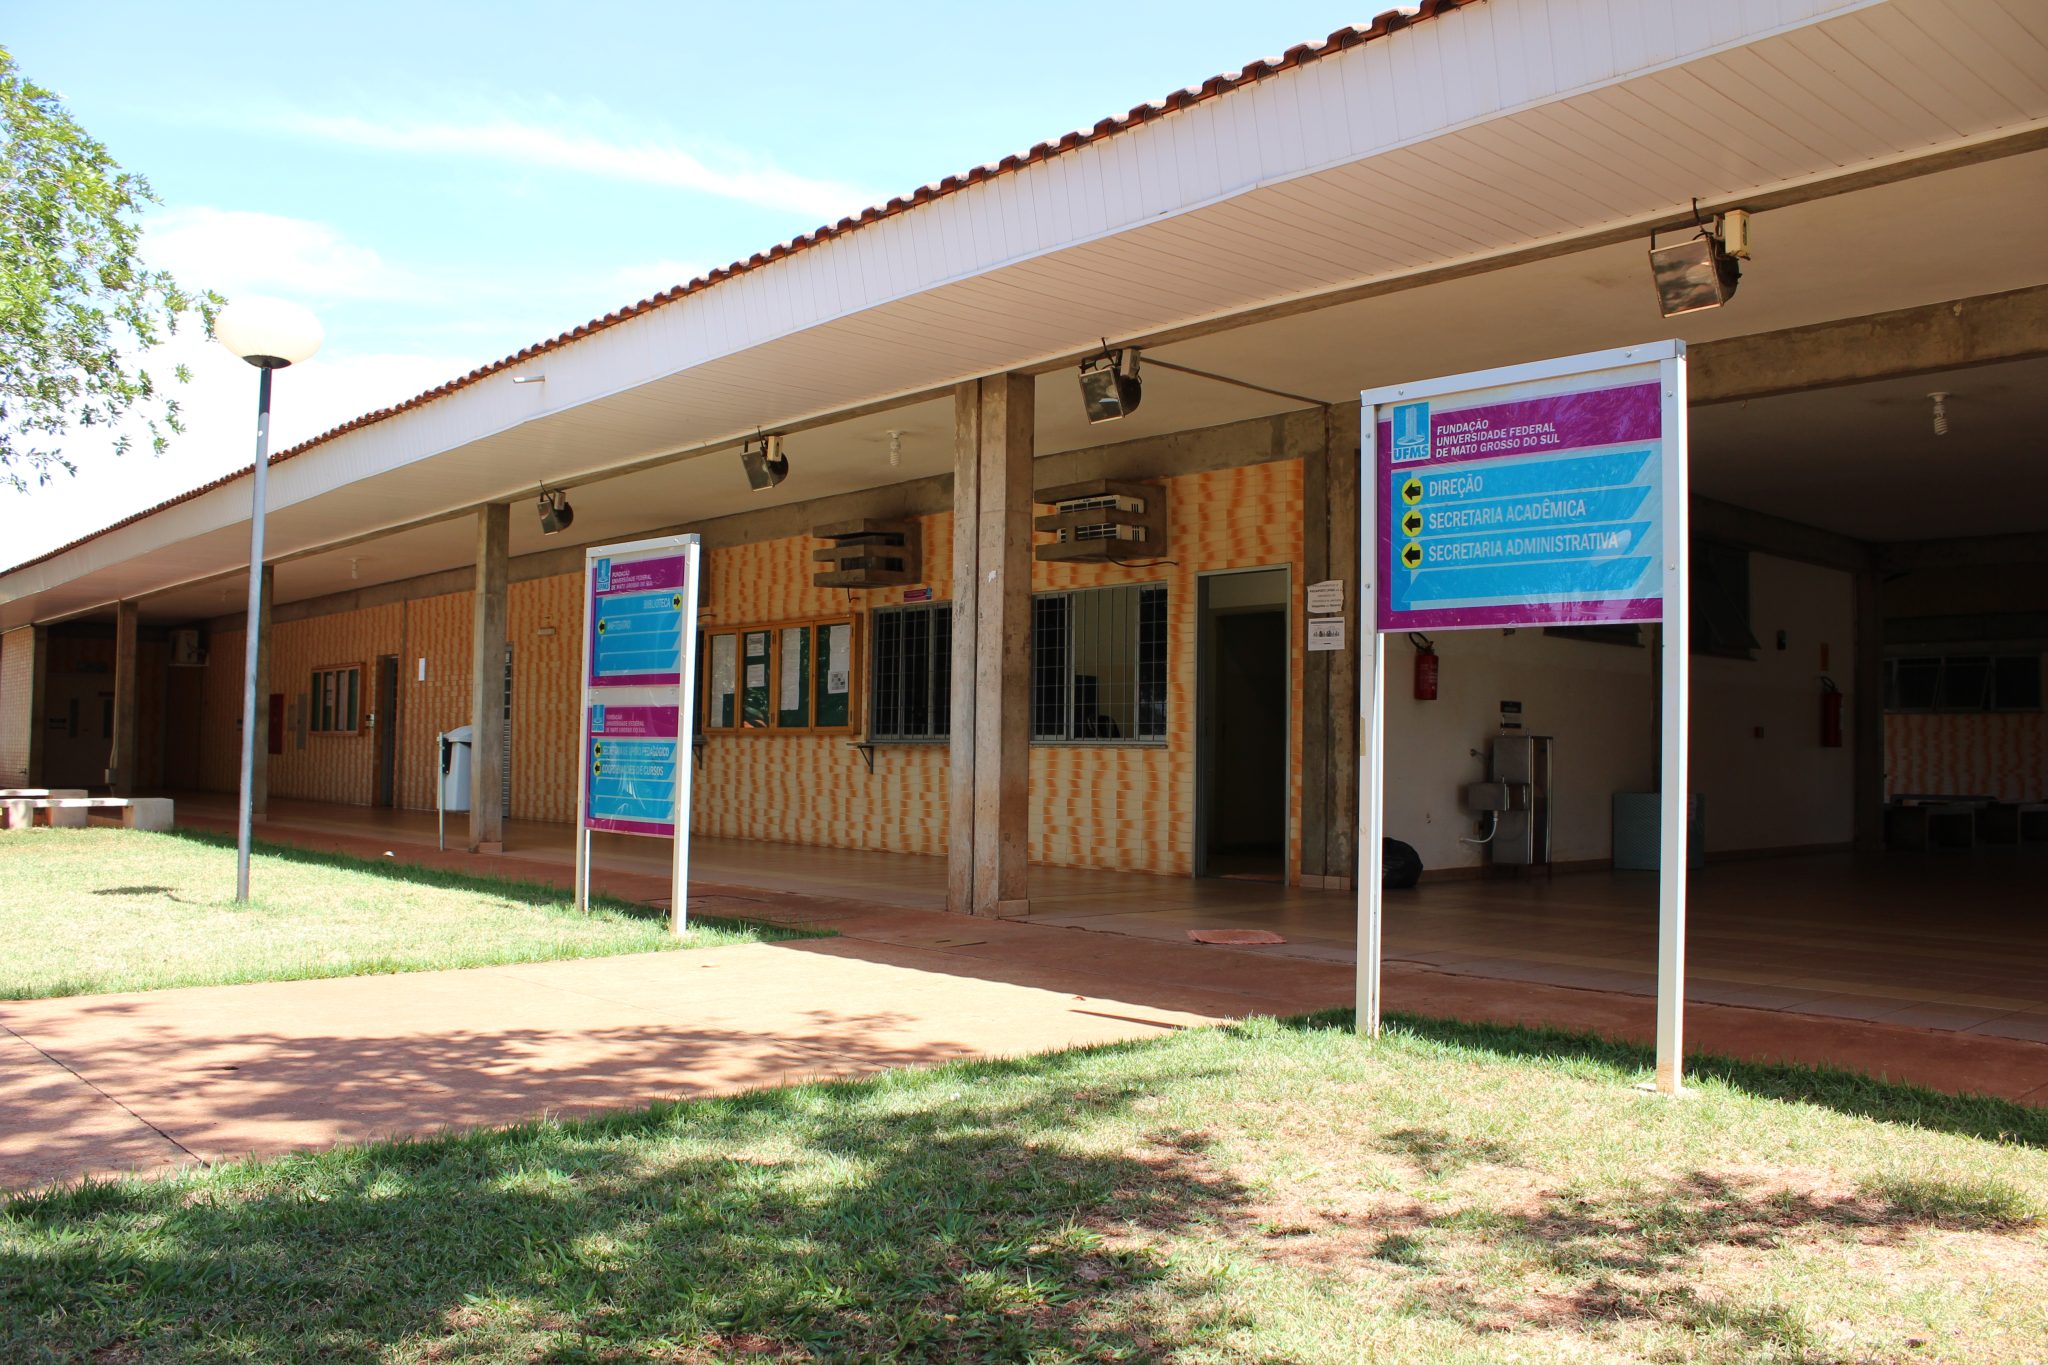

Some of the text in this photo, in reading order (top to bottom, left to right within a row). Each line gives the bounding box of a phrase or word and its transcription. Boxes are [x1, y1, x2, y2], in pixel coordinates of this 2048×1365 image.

[1436, 422, 1556, 447] UNIVERSIDADE FEDERAL
[1437, 419, 1489, 436] FUNDAÇÃO
[1393, 445, 1430, 461] UFMS
[1435, 433, 1560, 458] DE MATO GROSSO DO SUL
[1429, 473, 1483, 498] DIREÇÃO
[1428, 498, 1587, 530] SECRETARIA ACADÊMICA
[1428, 531, 1619, 562] SECRETARIA ADMINISTRATIVA
[643, 598, 670, 609] BIBLIOTECA
[642, 745, 670, 757] PEDAGÓGICO
[644, 766, 664, 776] CURSOS
